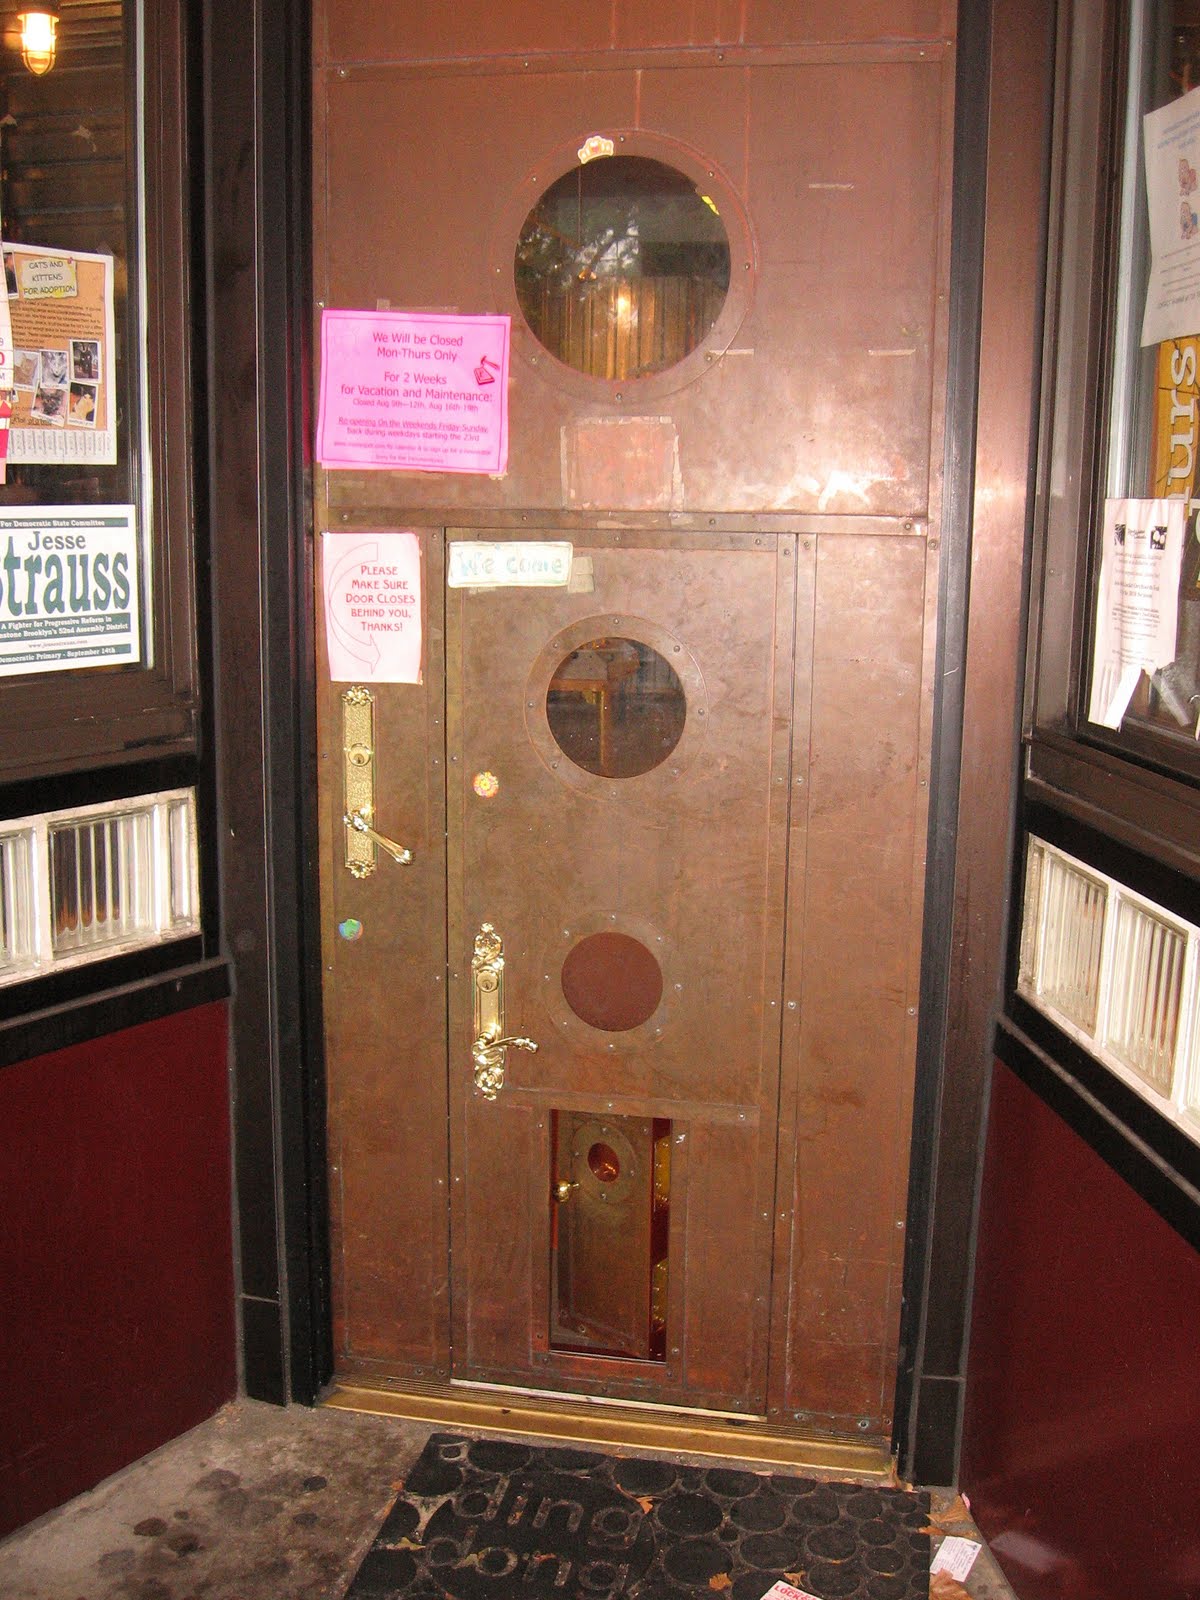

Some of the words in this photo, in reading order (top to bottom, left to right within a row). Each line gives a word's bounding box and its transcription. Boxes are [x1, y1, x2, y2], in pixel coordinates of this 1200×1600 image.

[29, 261, 48, 269] CATS
[49, 260, 64, 268] AND
[32, 273, 64, 282] KITTENS
[23, 287, 38, 295] FOR
[40, 284, 76, 294] ADOPTION
[373, 332, 389, 343] We
[391, 333, 411, 344] Will
[413, 334, 427, 345] be
[430, 335, 464, 347] Closed
[434, 349, 457, 363] Only
[384, 371, 400, 382] For
[403, 373, 410, 383] 2
[414, 373, 447, 385] Weeks
[341, 384, 354, 395] for
[358, 386, 399, 397] Vacation
[402, 388, 422, 398] and
[425, 389, 493, 402] Maintenance:
[353, 399, 375, 407] Closed
[376, 400, 390, 409] Aug
[429, 402, 443, 411] Aug
[402, 420, 438, 430] Weekends
[364, 428, 386, 438] during
[387, 430, 420, 439] weekdays
[422, 431, 448, 441] starting
[449, 433, 462, 441] the
[14, 520, 51, 528] Democratic
[52, 519, 69, 527] State
[71, 519, 105, 527] Committee
[28, 531, 86, 551] Jesse
[0, 536, 130, 617] trauss
[360, 565, 398, 576] PLEASE
[351, 579, 380, 590] MAKE
[383, 579, 409, 590] SURE
[345, 593, 374, 604] DOOR
[377, 593, 416, 604] CLOSES
[351, 608, 385, 617] BEHIND
[8, 621, 32, 631] Fighter
[34, 620, 43, 628] for
[44, 618, 80, 629] Progressive
[81, 616, 104, 624] Reform
[106, 615, 112, 623] in
[360, 621, 403, 632] THANKS!
[24, 628, 57, 638] Brooklyn's
[59, 626, 75, 634] 52nd
[76, 624, 105, 634] Assembly
[106, 622, 128, 631] District
[36, 652, 61, 662] Primary
[67, 649, 100, 659] September
[101, 647, 116, 655] 14th
